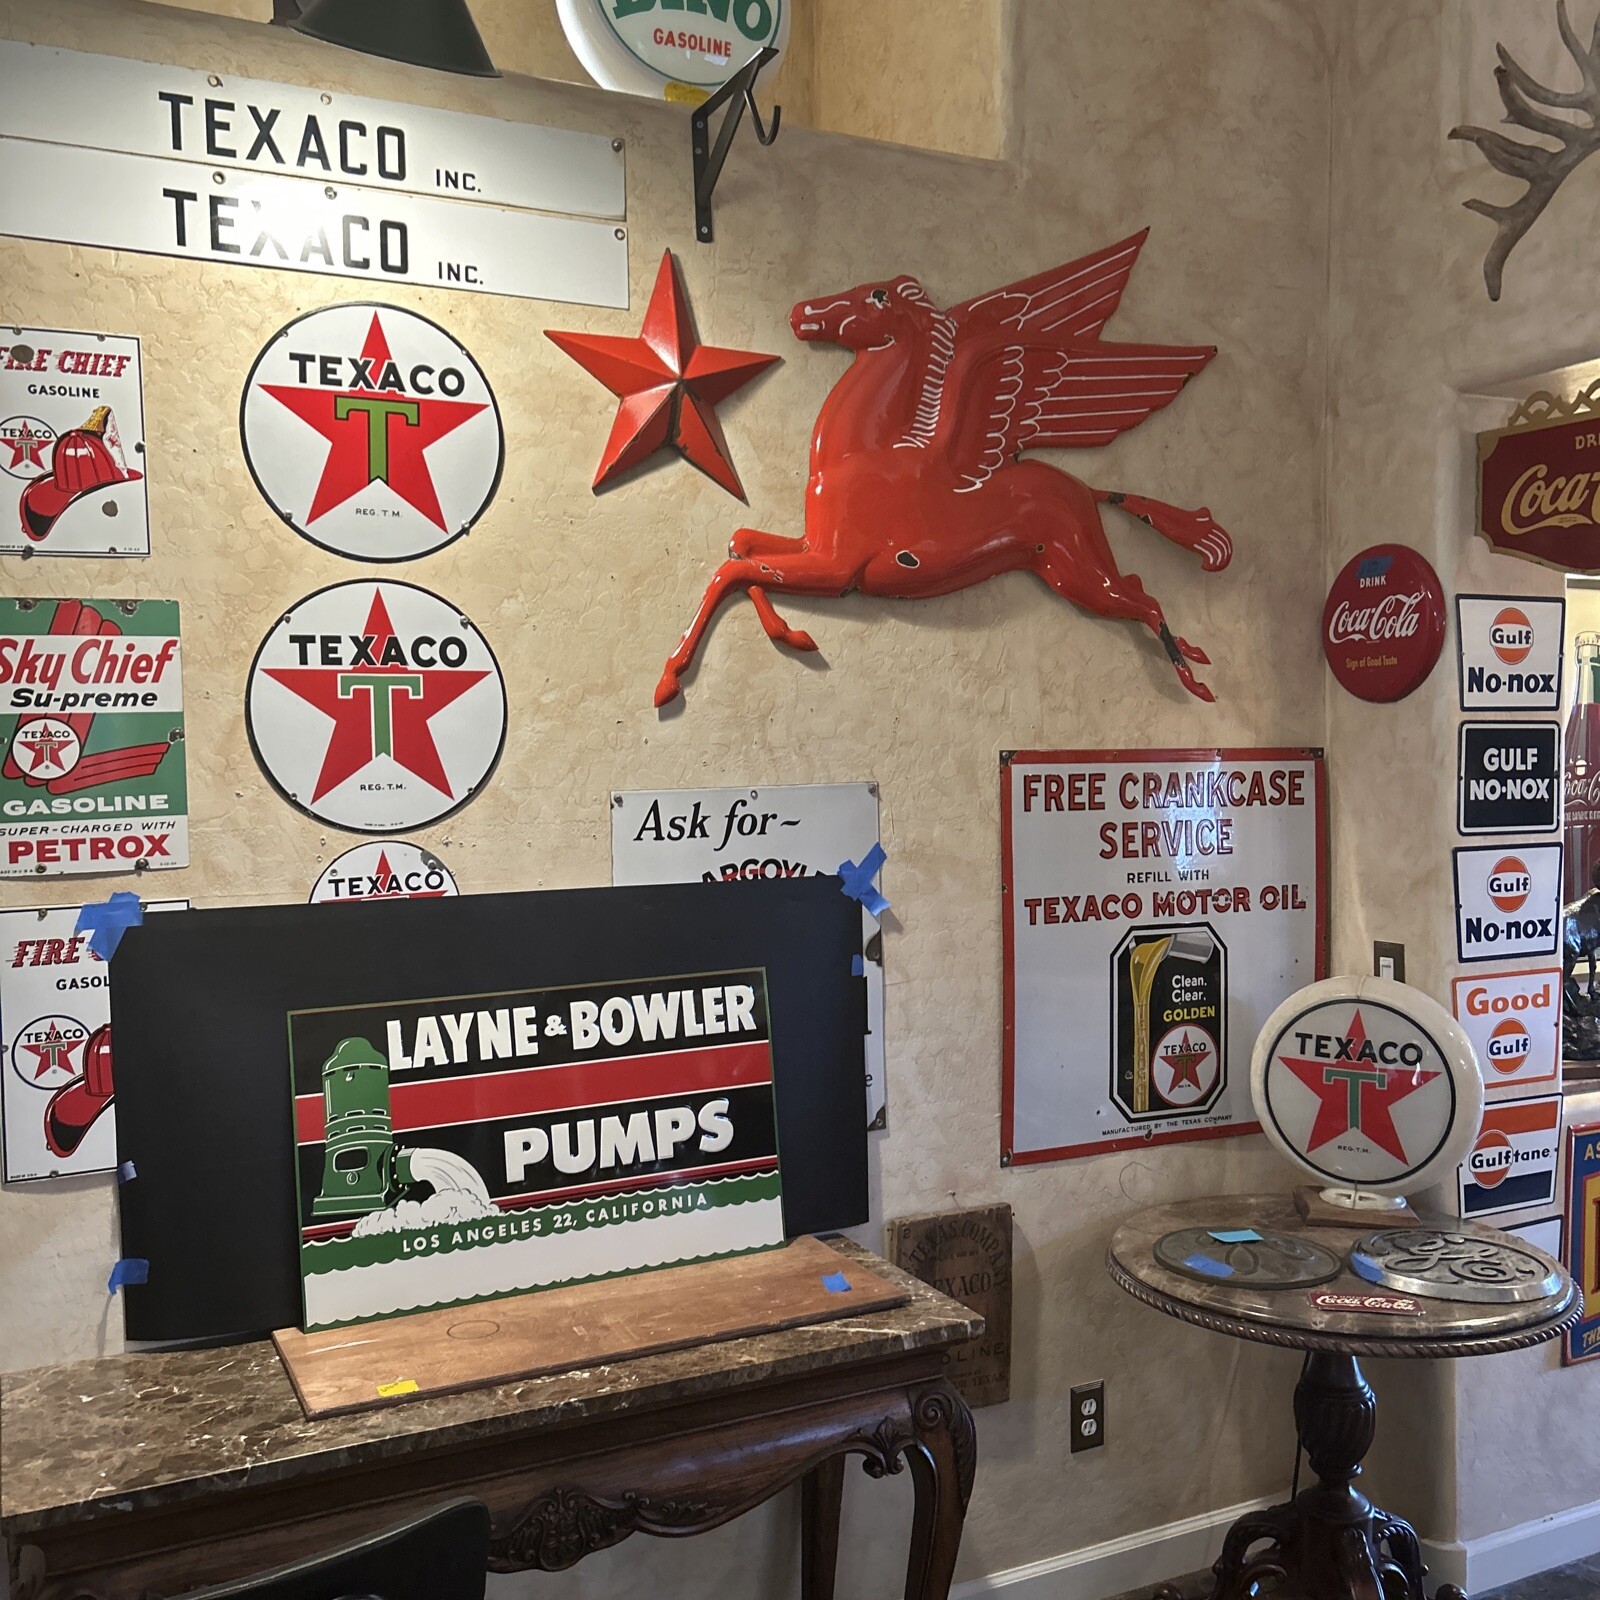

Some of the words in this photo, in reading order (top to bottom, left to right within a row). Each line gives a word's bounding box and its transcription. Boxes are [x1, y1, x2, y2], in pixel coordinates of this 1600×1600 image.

[653, 28, 732, 57] GASOLINE
[158, 91, 407, 182] TEXACO
[435, 168, 482, 193] INC.
[162, 187, 409, 275] TEXACO
[437, 261, 484, 285] INC.
[58, 350, 131, 378] CHIEF
[289, 352, 466, 397] TEXACO
[28, 384, 100, 399] GASOLINE
[1, 428, 52, 440] TEXACO
[1575, 432, 1600, 450] DR
[355, 507, 379, 517] REG.
[1360, 575, 1387, 588] DRINK
[1329, 592, 1425, 644] Coca-Cola
[1491, 627, 1532, 645] Gulf
[289, 634, 468, 668] TEXACO
[1346, 657, 1358, 671] Sign
[1360, 656, 1367, 668] of
[1367, 655, 1382, 667] Good
[1382, 654, 1398, 666] Taste
[0, 638, 66, 690] Sky
[71, 638, 178, 684] Chief
[10, 688, 158, 712] Su-preme
[22, 729, 71, 740] TEXACO
[1483, 747, 1538, 772] GULF
[360, 783, 385, 791] REG.
[1023, 772, 1107, 812] FREE
[1119, 769, 1305, 810] CRANKCASE
[3, 794, 169, 817] GASOLINE
[141, 821, 177, 831] WITH
[633, 799, 711, 841] Ask
[8, 833, 171, 865] PETROX
[1099, 818, 1234, 860] SERVICE
[328, 870, 445, 898] TEXACO
[1127, 871, 1172, 884] REFILL
[1178, 869, 1210, 881] WITH
[1489, 877, 1530, 893] Gulf
[1024, 892, 1143, 926] TEXACO
[1153, 886, 1251, 917] MOTOR
[1260, 884, 1307, 910] OIL
[11, 936, 85, 968] FIRE
[1171, 974, 1207, 989] Clean.
[1171, 989, 1206, 1003] Clear.
[1466, 984, 1551, 1016] Good
[1163, 1005, 1216, 1022] GOLDEN
[24, 1028, 84, 1043] TEXACO
[386, 1006, 540, 1072] LAYNE
[544, 1015, 567, 1037] &
[569, 984, 758, 1050] BOWLER
[1163, 1042, 1207, 1055] TEXACO
[1295, 1032, 1423, 1066] TEXACO
[1489, 1037, 1529, 1056] Gulf
[1102, 1124, 1151, 1136] MANUFACTURED
[1182, 1118, 1201, 1126] TEXAS
[1204, 1115, 1233, 1123] COMPANY
[503, 1098, 734, 1184] PUMPS
[1471, 1146, 1551, 1170] Gulftane
[403, 1233, 440, 1253] LOS
[451, 1218, 541, 1246] ANGELES
[553, 1214, 579, 1230] 22,
[585, 1193, 708, 1223] CALIFORNIA
[934, 1270, 992, 1298] EXACO
